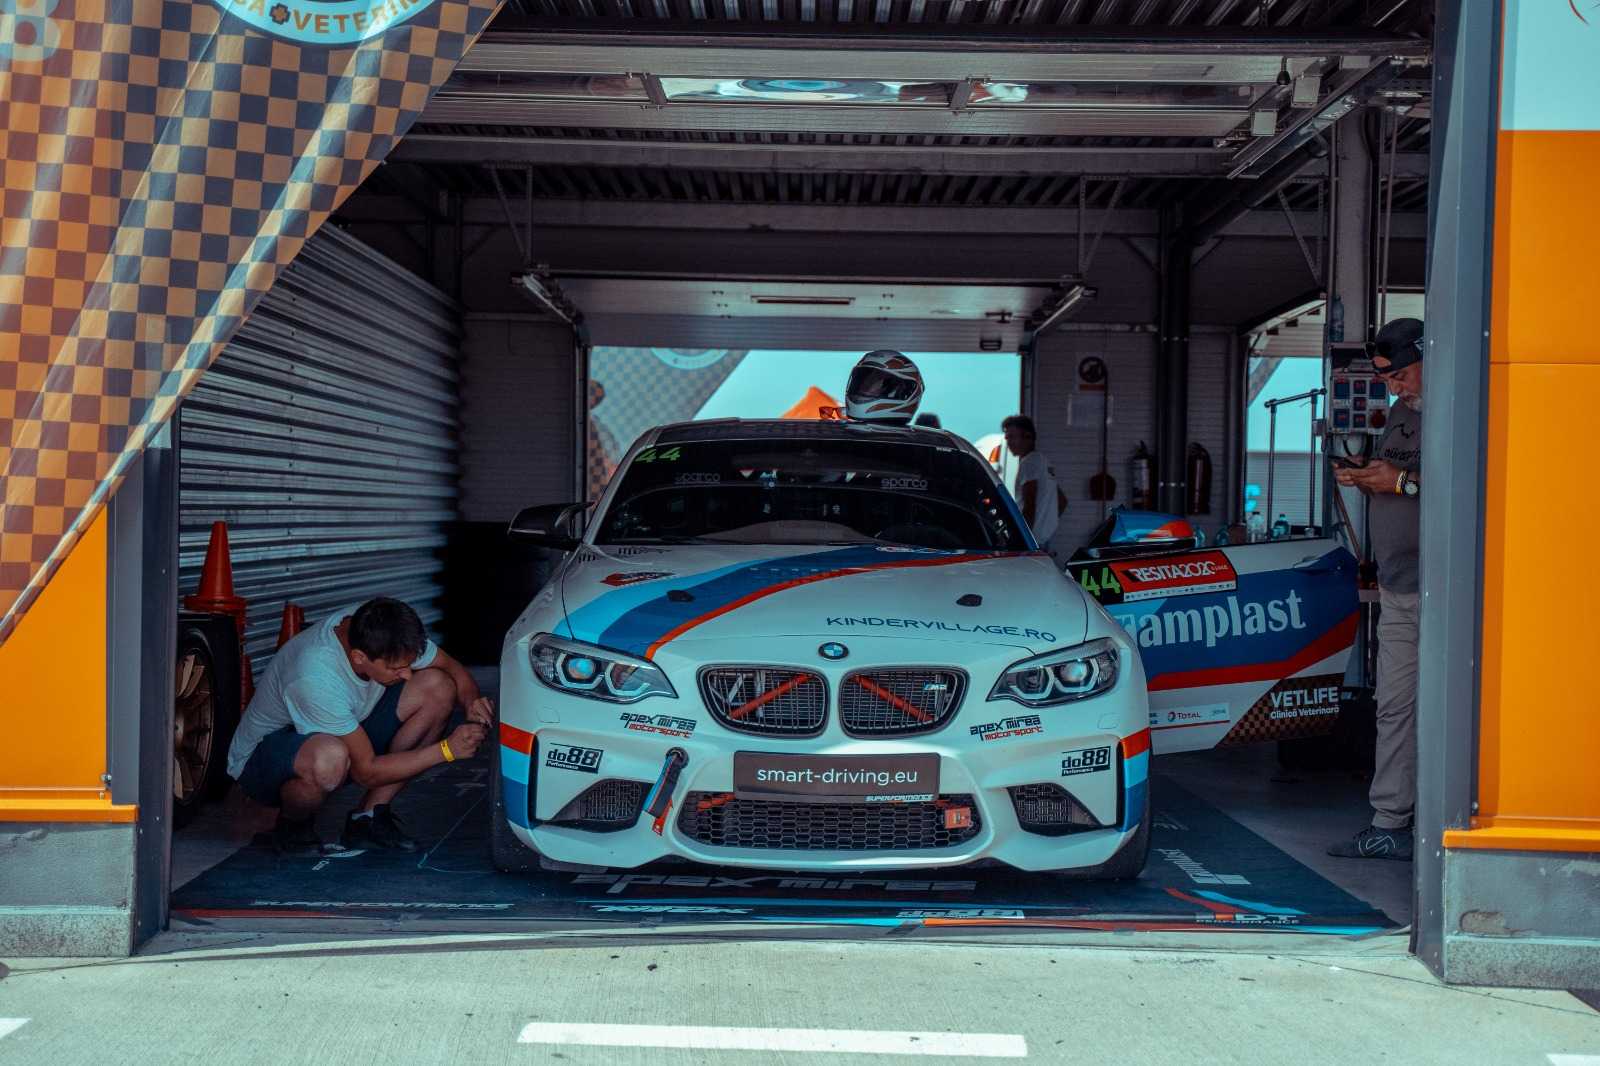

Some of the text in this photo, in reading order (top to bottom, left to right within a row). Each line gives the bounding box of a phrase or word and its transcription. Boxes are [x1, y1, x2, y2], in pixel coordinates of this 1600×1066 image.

[634, 446, 681, 463] 44
[881, 478, 928, 490] sparco
[1081, 566, 1121, 597] 44
[826, 616, 1057, 643] KINDERVILLAGE.RO
[1270, 686, 1339, 708] VETLIFE
[620, 712, 697, 731] apex mirea
[628, 723, 693, 739] motorsport
[970, 715, 1042, 741] apex mirea
[984, 725, 1044, 741] motorsport
[547, 748, 600, 768] do88
[1061, 749, 1109, 769] do88
[756, 768, 918, 786] smart-driving.eu
